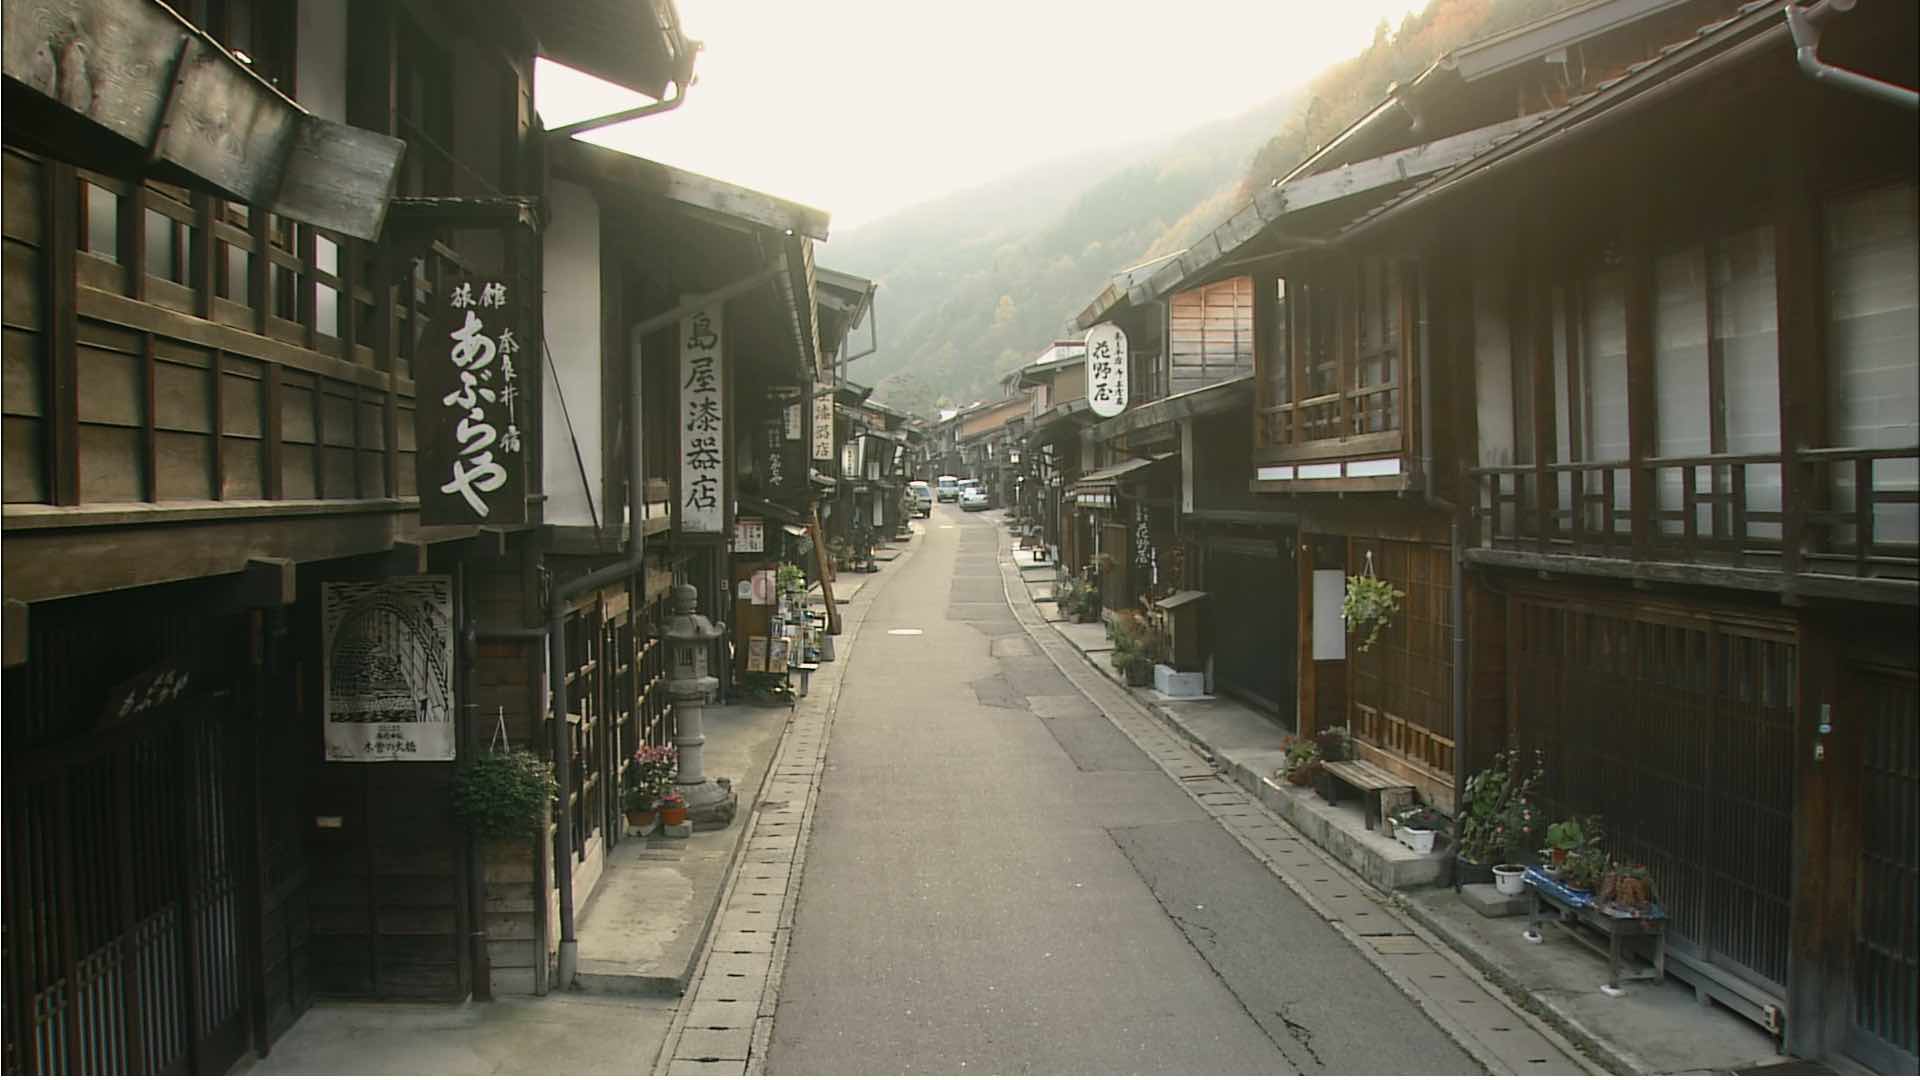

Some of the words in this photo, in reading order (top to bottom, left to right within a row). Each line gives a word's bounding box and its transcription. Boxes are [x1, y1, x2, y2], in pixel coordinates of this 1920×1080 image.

[450, 281, 508, 309] 旅館
[441, 311, 508, 518] あぶらや
[684, 311, 722, 511] 島屋漆器店
[815, 394, 831, 457] 漆器店
